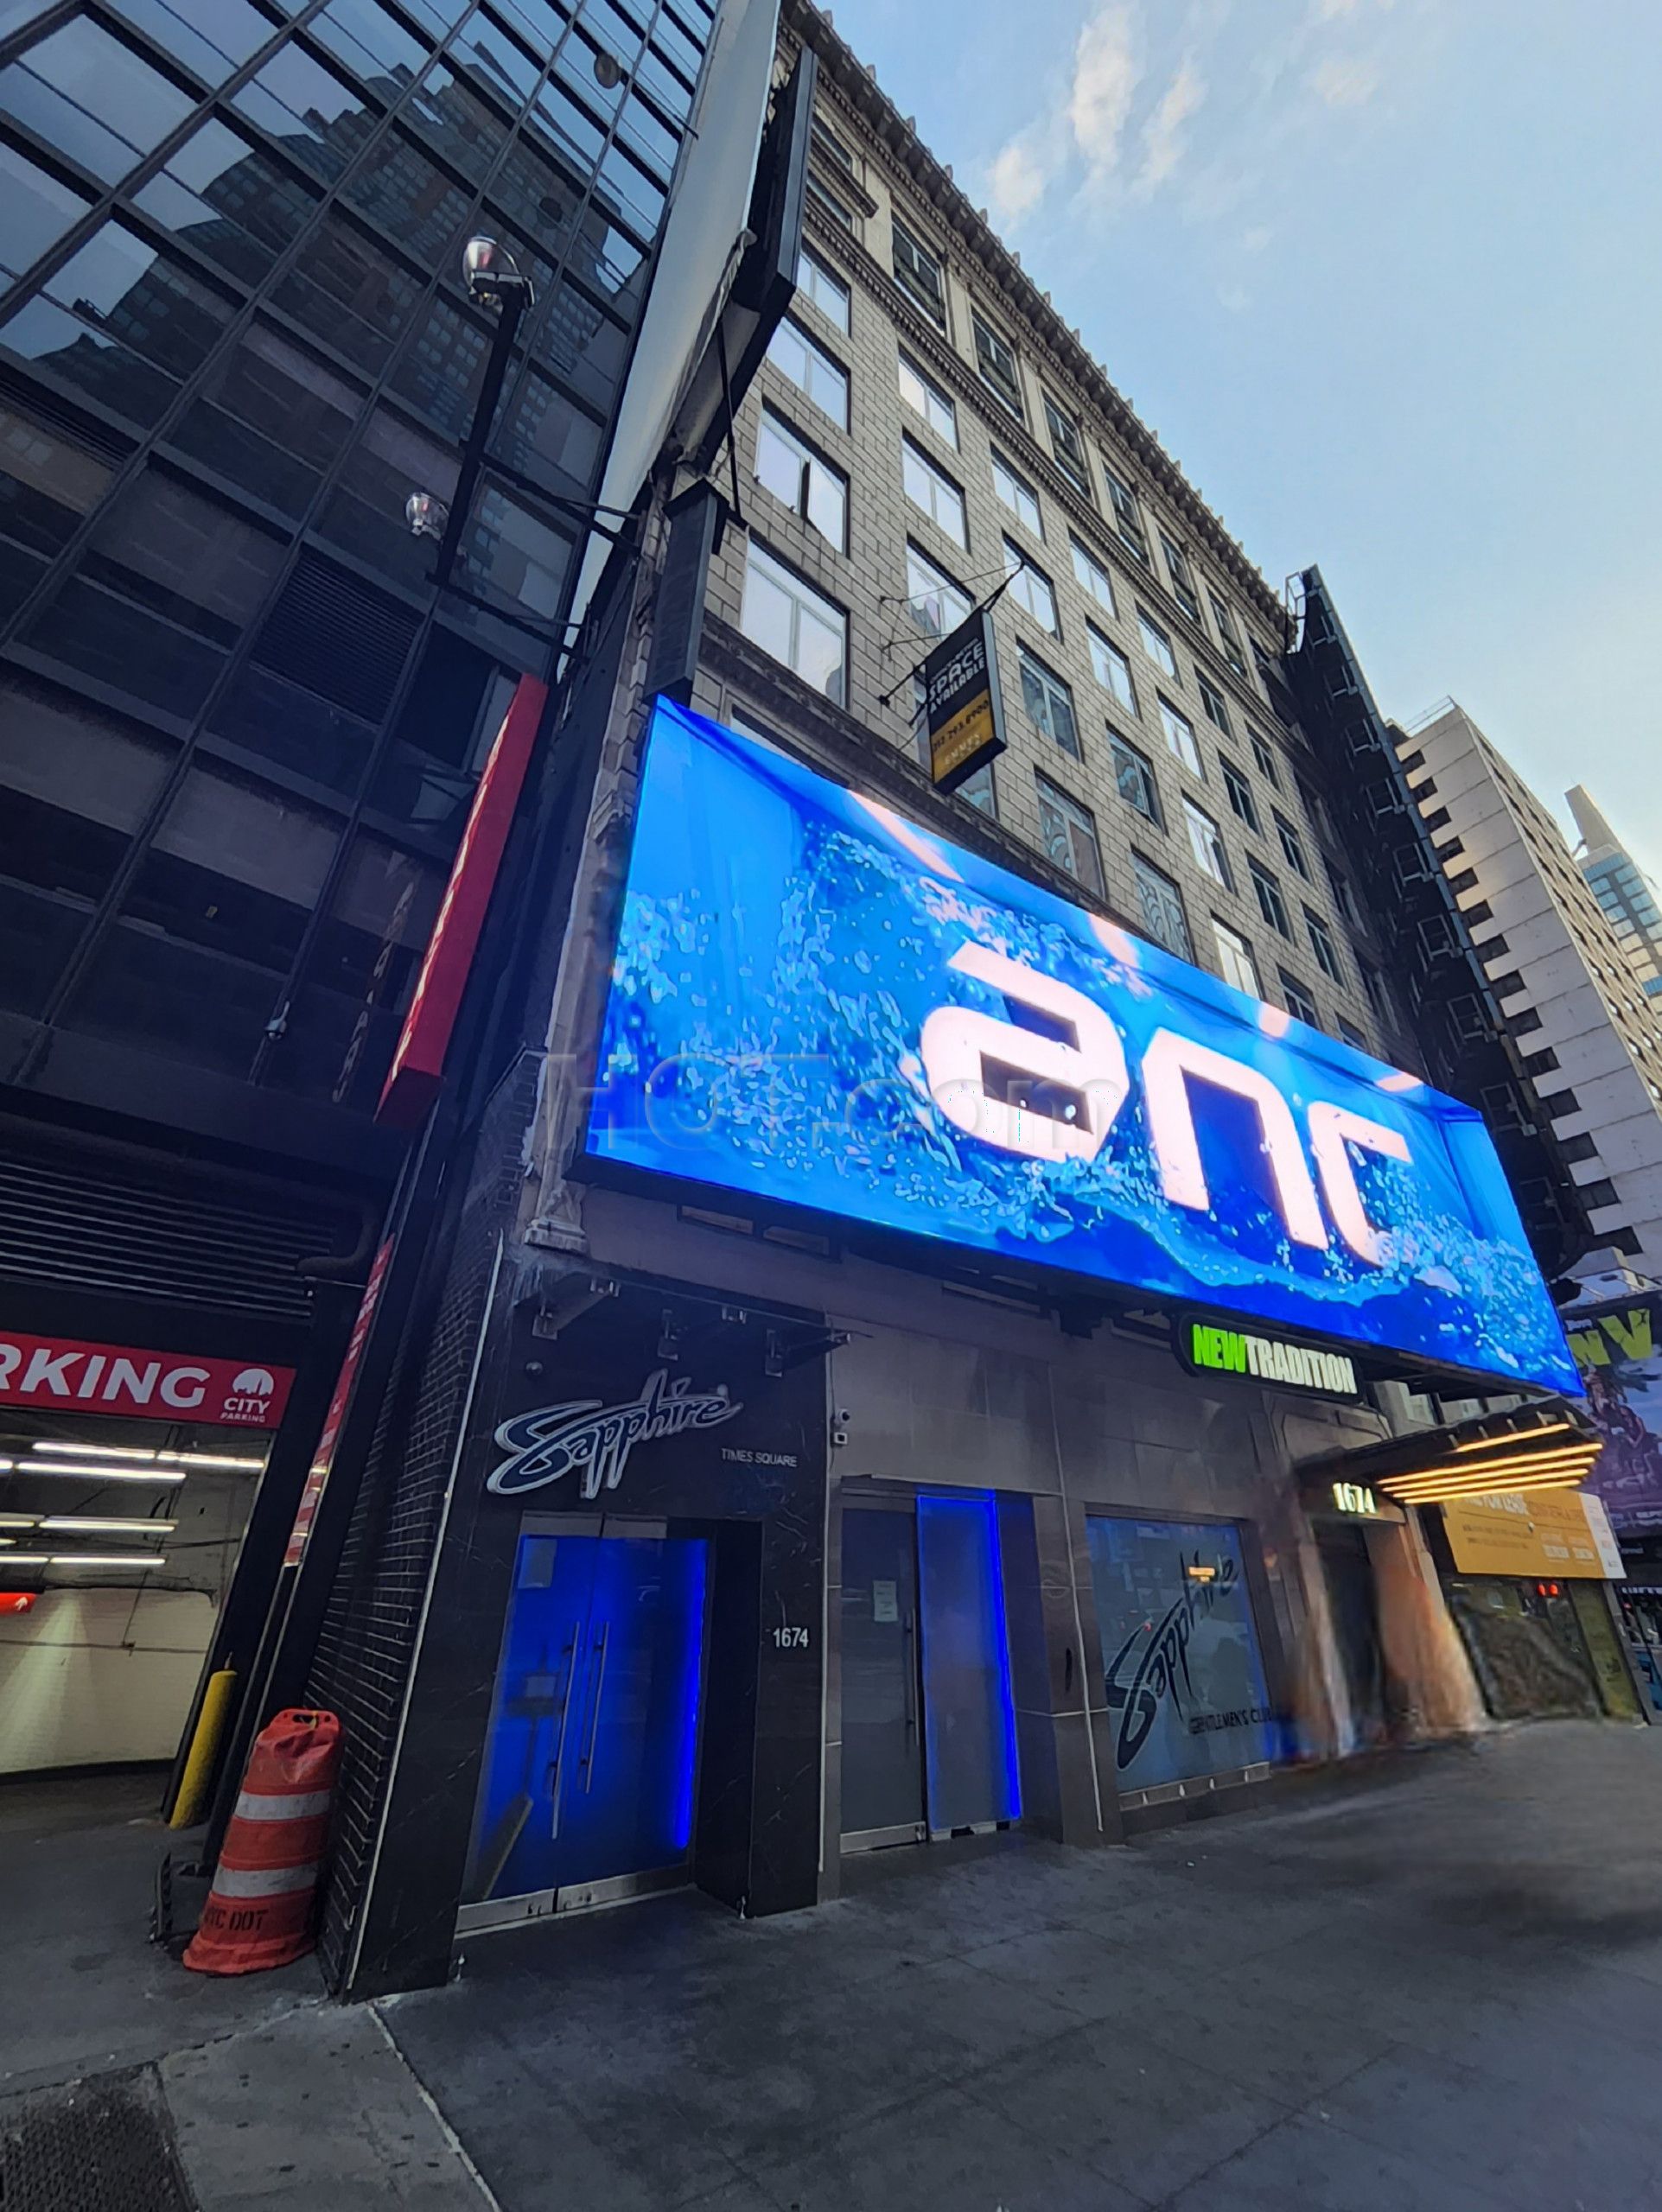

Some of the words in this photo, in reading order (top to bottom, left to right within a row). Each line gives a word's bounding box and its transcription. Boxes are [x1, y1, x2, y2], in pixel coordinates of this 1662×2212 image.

[929, 641, 984, 702] SPACE
[930, 657, 985, 714] AVAILABLE
[224, 1396, 271, 1414] CITY
[220, 1412, 266, 1423] PARKING
[486, 1369, 744, 1499] Sapphire
[721, 1447, 754, 1463] TIMES
[755, 1452, 798, 1468] SQUARE
[1333, 1483, 1377, 1514] 1674
[773, 1627, 809, 1648] 1674
[229, 1908, 269, 1930] DOT
